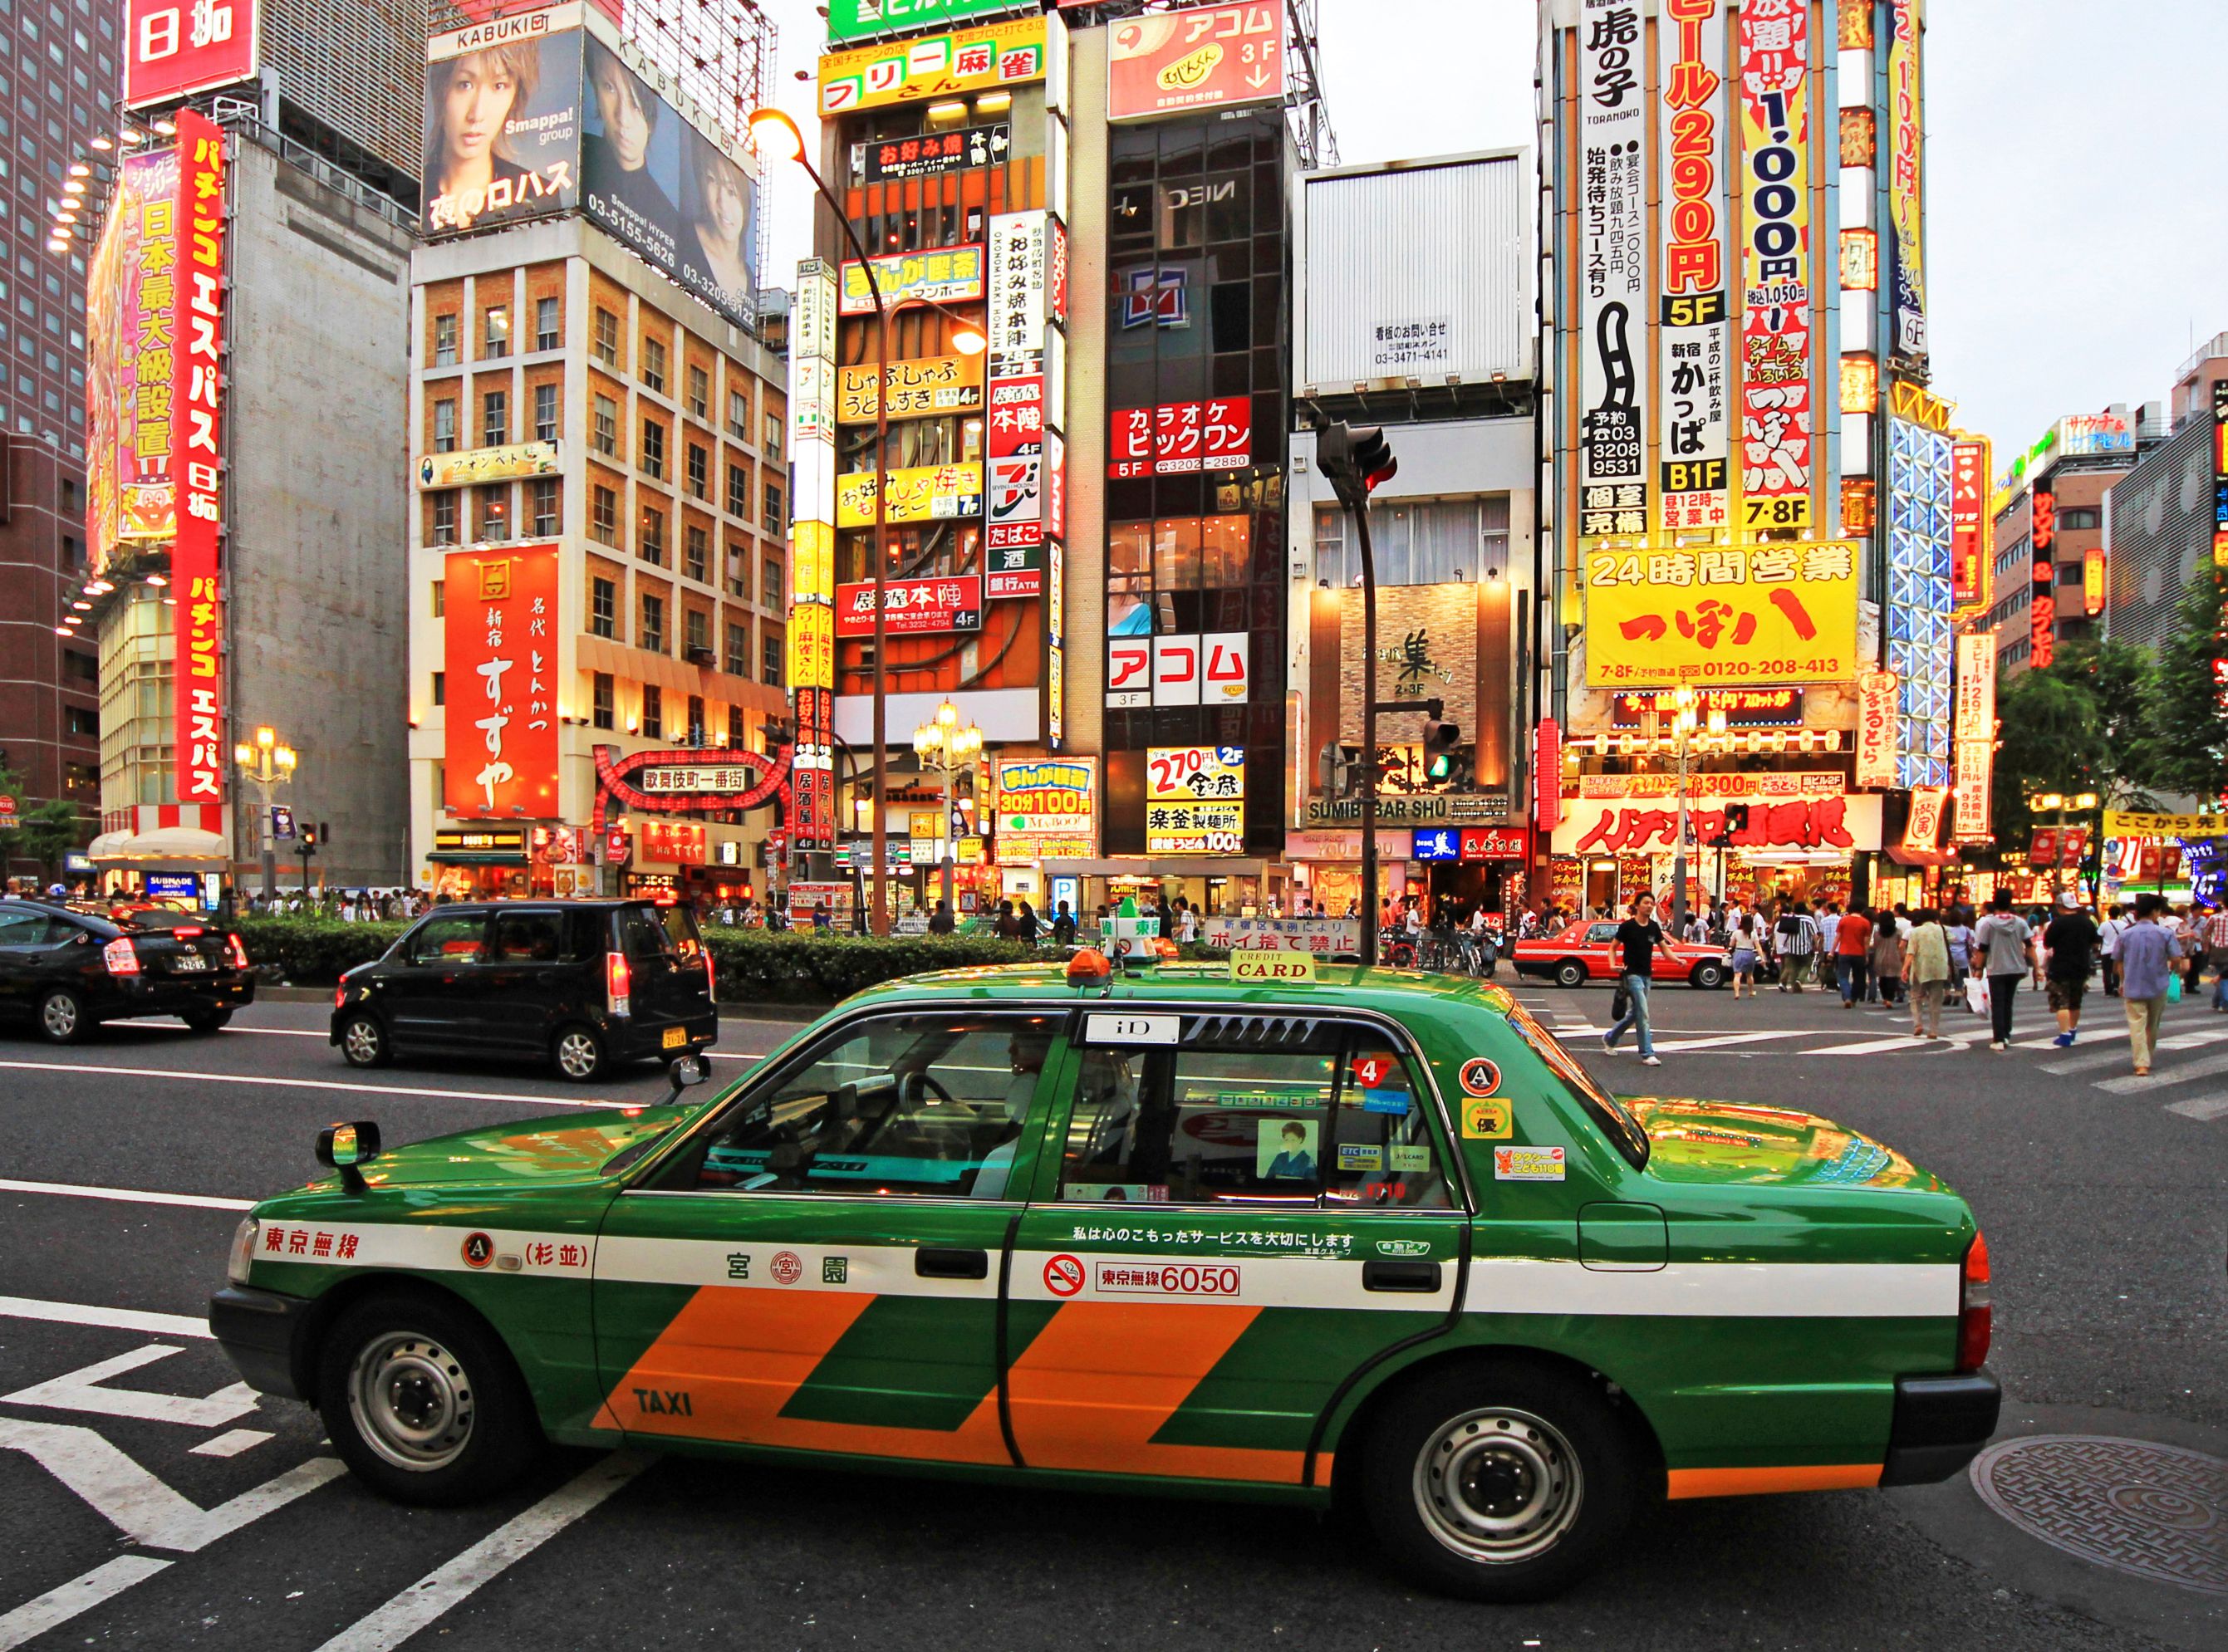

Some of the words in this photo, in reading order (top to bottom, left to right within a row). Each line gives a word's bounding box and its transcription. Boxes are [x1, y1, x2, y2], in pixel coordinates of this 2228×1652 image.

[955, 20, 1045, 42] 女流プロと打てる店
[1185, 7, 1273, 42] アコム
[823, 43, 905, 69] 全国チェーンの店
[1241, 40, 1276, 63] 3F
[1586, 7, 1638, 107] 虎の子
[826, 50, 1035, 108] フリー麻雀
[1163, 49, 1217, 84] むじんくん
[897, 78, 963, 98] さん
[505, 108, 573, 135] Smappa!
[1586, 108, 1639, 125] TORANOKO
[538, 125, 573, 146] group
[970, 130, 987, 166] 本陣
[880, 134, 964, 164] お好み焼
[429, 159, 572, 231] 夜のロハス
[1754, 92, 1797, 281] 1,000円
[192, 137, 222, 267] パチンコ
[1587, 147, 1607, 298] 始発待ちコース有り
[1609, 157, 1623, 274] 飲み放題九四五円
[587, 194, 675, 267] 03-5155-5626
[648, 222, 676, 250] HYPER
[844, 248, 979, 298] まんが喫茶
[993, 232, 1002, 304] OKONOMIYAKI
[683, 263, 755, 327] 03-3205-3122
[912, 285, 966, 299] マンボー
[1007, 237, 1028, 347] お好み焼本陣
[1670, 297, 1718, 325] 5F
[135, 199, 177, 458] 日本最大級設置
[993, 309, 1002, 348] HONJIN
[1376, 321, 1446, 341] 看板のお問い合せ
[1905, 318, 1924, 346] 6F
[189, 271, 218, 455] エスパス
[1376, 349, 1447, 365] 03-3471-4141
[1671, 342, 1700, 358] 新宿
[1749, 350, 1804, 367] サービス
[846, 358, 959, 392] しゃぶしゃぶ
[1708, 327, 1721, 423] 平成の一杯飲み屋
[1748, 368, 1803, 383] いろいろ
[846, 389, 930, 416] うどんすき
[959, 386, 979, 404] 4F
[992, 383, 1042, 404] 居酒屋
[992, 407, 1042, 434] 本陣
[1129, 402, 1228, 429] カラオケ
[1593, 410, 1626, 426] 予約
[1671, 361, 1706, 454] かっぱ
[1612, 427, 1635, 440] 03
[2069, 414, 2127, 432] サウナ&
[1018, 443, 1040, 455] 4F
[1128, 424, 1250, 458] ビックワン
[1592, 443, 1639, 457] 3208
[1744, 388, 1807, 492] つぼ八
[2069, 431, 2132, 450] カプセル
[1118, 461, 1142, 477] 5F
[1169, 455, 1246, 471] 3202-2880
[1593, 460, 1637, 474] 9531
[1670, 462, 1721, 489] B1F
[188, 461, 218, 522] 日拓
[934, 467, 976, 494] 焼き
[959, 495, 979, 515] 7F
[1587, 485, 1642, 507] 個室
[1584, 511, 1643, 533] 完備
[1665, 507, 1725, 527] 営業中
[2033, 492, 2055, 549] サウナ
[990, 525, 1039, 545] たばこ
[1003, 551, 1026, 569] 酒
[1592, 546, 1853, 587] 24時間営業
[2033, 561, 2054, 582] &
[189, 577, 216, 678] パチンコ
[486, 606, 503, 648] 新宿
[528, 597, 546, 637] 名代
[955, 610, 975, 626] 4F
[1618, 587, 1818, 650] つぼ八
[797, 606, 814, 678] フリー麻雀さん
[820, 607, 831, 679] フリー麻雀さん
[2030, 595, 2055, 669] カプセル
[1111, 645, 1245, 687] アコム
[1398, 628, 1432, 680] 集
[1703, 659, 1839, 676] 0120-208-413
[528, 650, 548, 733] とんかつ
[1119, 694, 1138, 706] 3F
[797, 689, 815, 744] お好み焼
[1863, 691, 1883, 764] まるとら
[1882, 695, 1896, 752] 焼肉ホルモン
[190, 689, 218, 796] エスパス
[474, 656, 514, 810] すずや
[1221, 747, 1244, 764] 2F
[645, 770, 743, 788] 歌舞伎町一番街
[1003, 766, 1088, 790] まんが喫茶
[1705, 775, 1759, 794] 300円
[797, 772, 813, 825] 居酒屋
[1000, 791, 1091, 813] 30分100円
[1309, 801, 1362, 819] SUMIB
[798, 839, 812, 850] 4F
[1058, 882, 1071, 899] P
[1224, 919, 1342, 933] 新宿区条例により
[1210, 931, 1356, 952] ポイ捨て禁止
[1240, 953, 1283, 961] CREDIT
[1237, 963, 1307, 978] CARD
[1116, 1021, 1151, 1036] iD
[1361, 1061, 1377, 1081] 4
[1469, 1066, 1490, 1086] A
[1477, 1118, 1498, 1133] 優
[1513, 1151, 1552, 1162] タクシー
[1513, 1163, 1564, 1174] こども110番
[265, 1227, 360, 1259] 東京無線
[469, 1238, 487, 1257] A
[1072, 1226, 1354, 1248] 私は心のこもったサービスを大切にします
[1381, 1242, 1428, 1250] 自動ドア
[726, 1252, 751, 1280] 宮
[822, 1256, 847, 1284] 園
[1102, 1269, 1159, 1287] 東京無線
[1161, 1267, 1239, 1293] 6050
[632, 1388, 693, 1418] TAXI
